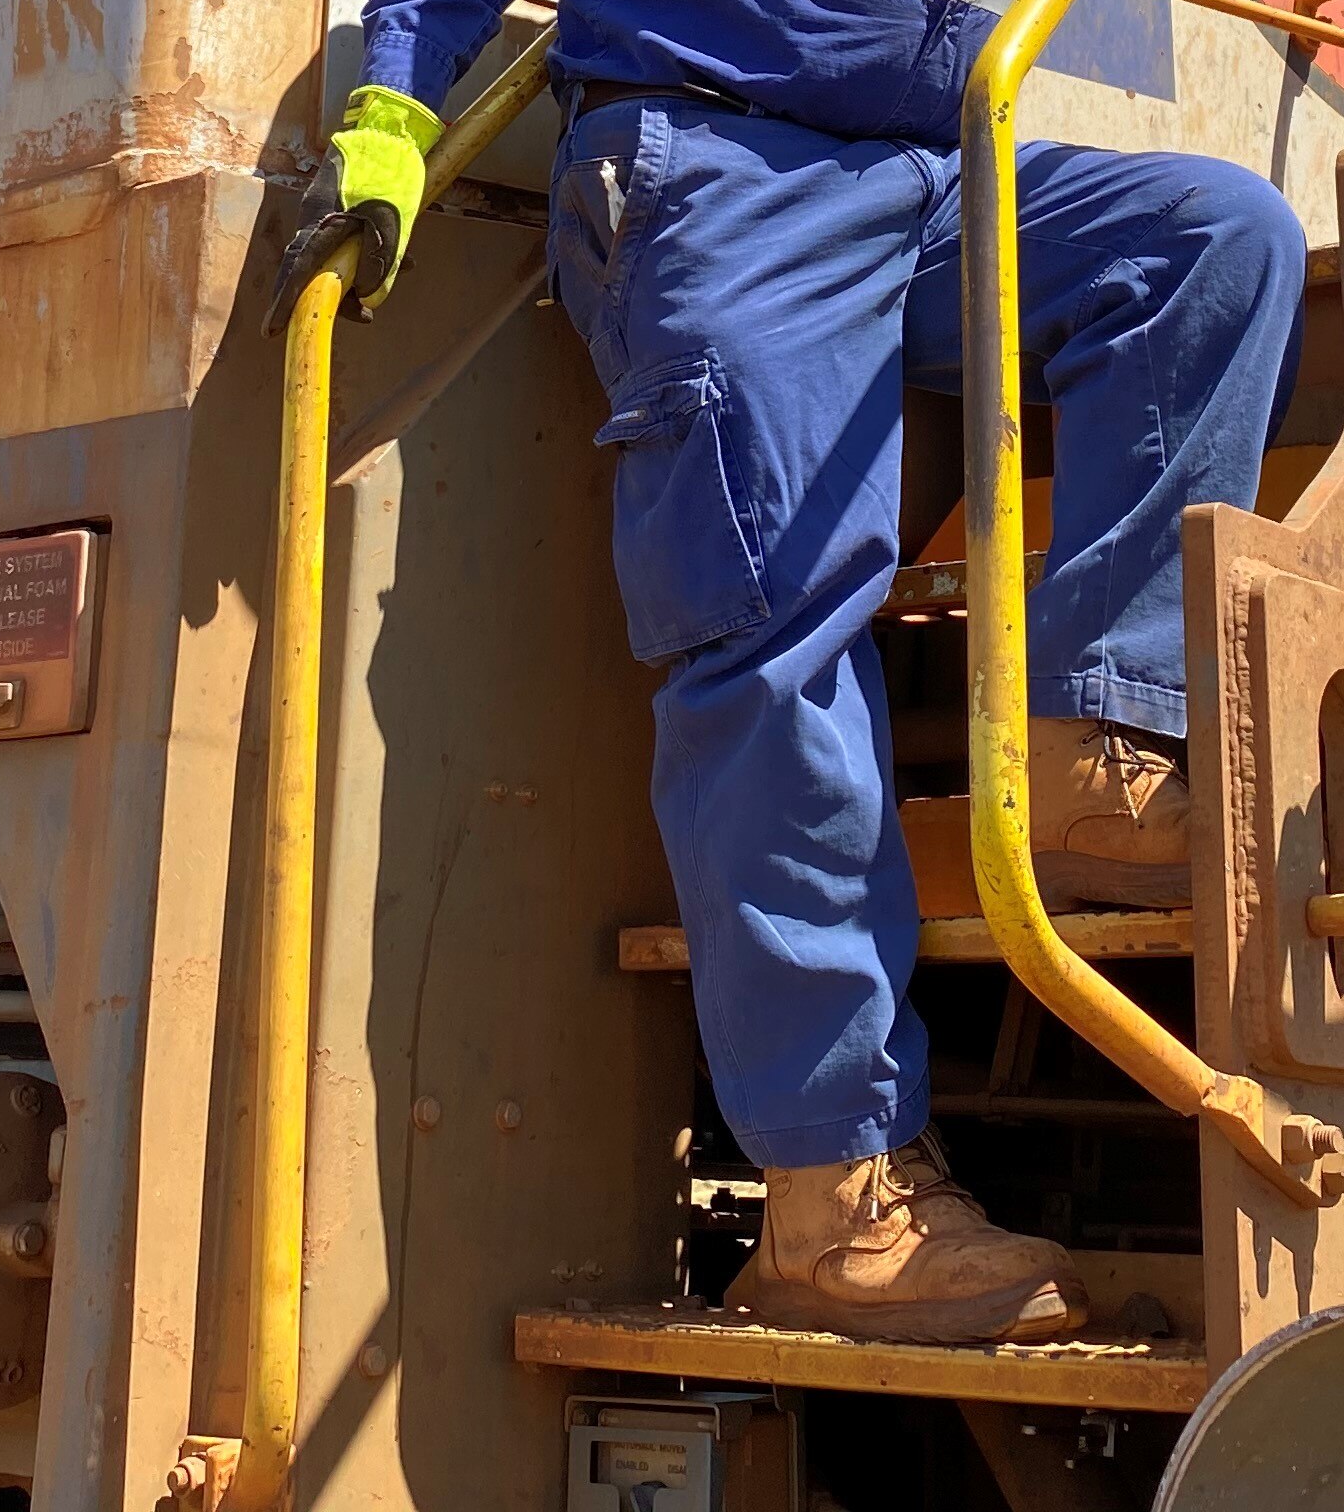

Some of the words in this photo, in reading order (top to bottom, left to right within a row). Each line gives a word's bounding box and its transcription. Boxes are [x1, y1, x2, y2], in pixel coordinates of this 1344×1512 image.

[4, 550, 63, 575] SYSTEM
[25, 577, 67, 601] FOAM
[667, 1463, 687, 1475] DISA
